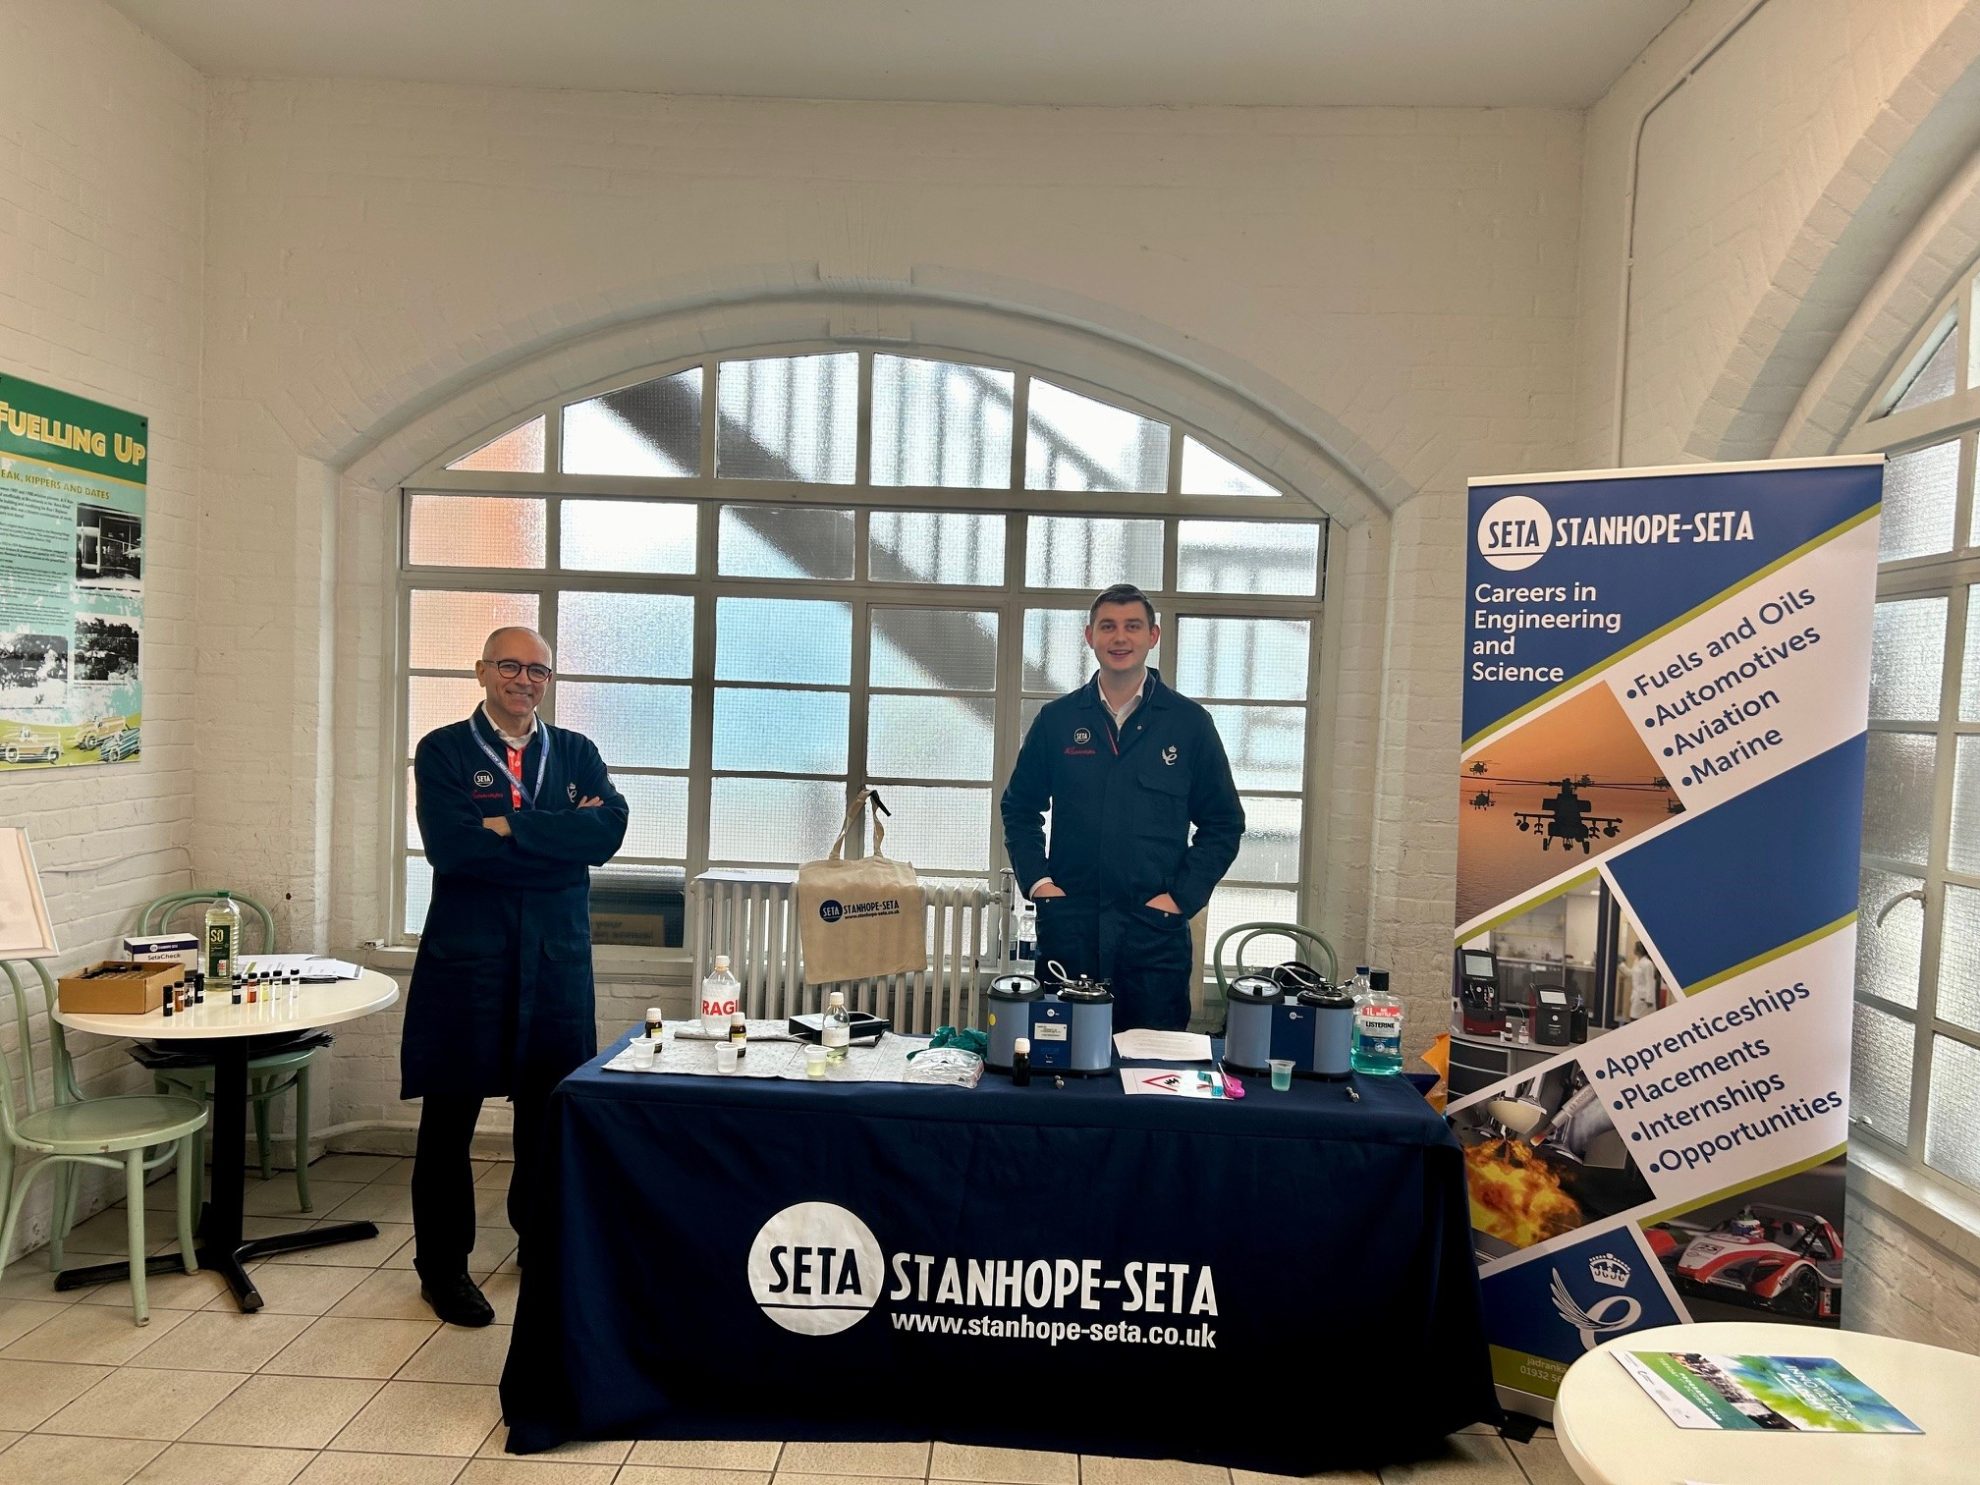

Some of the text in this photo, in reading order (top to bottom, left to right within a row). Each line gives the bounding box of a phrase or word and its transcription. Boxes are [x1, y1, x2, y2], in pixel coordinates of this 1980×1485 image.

[0, 401, 106, 457] FUELLING
[25, 475, 60, 489] KIPPERS
[63, 483, 82, 494] AND
[85, 487, 109, 500] DATES
[1488, 510, 1754, 548] SETA STANHOPE-SETA
[1475, 582, 1597, 603] Careers in
[1474, 609, 1621, 633] Engineering
[1634, 588, 1816, 697] Fuels and Oils
[1472, 636, 1515, 656] and
[1472, 662, 1564, 682] Science
[1655, 626, 1821, 727] Automotives
[1673, 689, 1780, 755] Aviation
[476, 775, 490, 783] SETA
[1690, 728, 1783, 784] Marine
[822, 900, 899, 917] SETA STANHOPE-SETA
[148, 953, 181, 961] SetaCheck
[1605, 981, 1810, 1079] Apprenticeships
[1621, 1038, 1770, 1109] Placements
[1638, 1073, 1785, 1141] Internships
[1659, 1090, 1842, 1171] Opportunities
[768, 1245, 1219, 1317] SETA STANHOPE-SETA
[891, 1311, 1217, 1350] www.stanhope-seta.co.uk
[1520, 1364, 1549, 1381] 01932
[1784, 1365, 1858, 1420] INNOVATION
